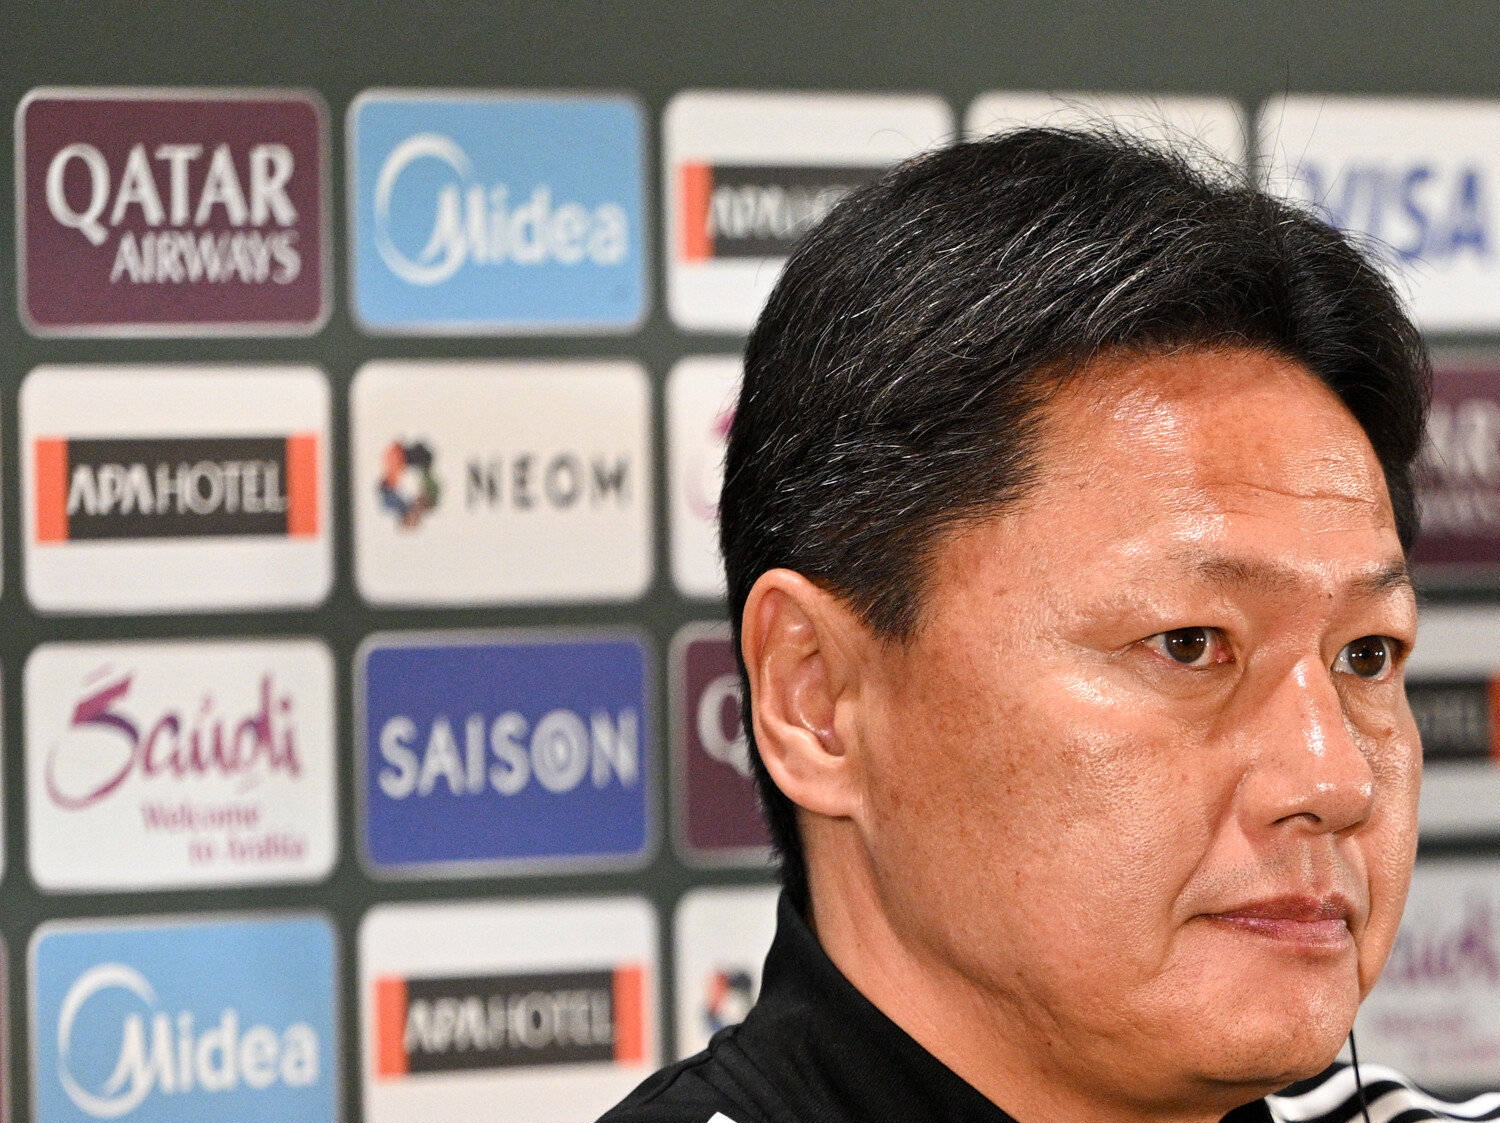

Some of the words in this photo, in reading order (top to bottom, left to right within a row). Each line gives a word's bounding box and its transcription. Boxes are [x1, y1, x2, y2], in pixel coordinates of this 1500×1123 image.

[46, 143, 298, 246] QATAR
[110, 231, 301, 284] AIRWAYS
[465, 454, 634, 512] NEOM
[378, 707, 639, 801] SAISON
